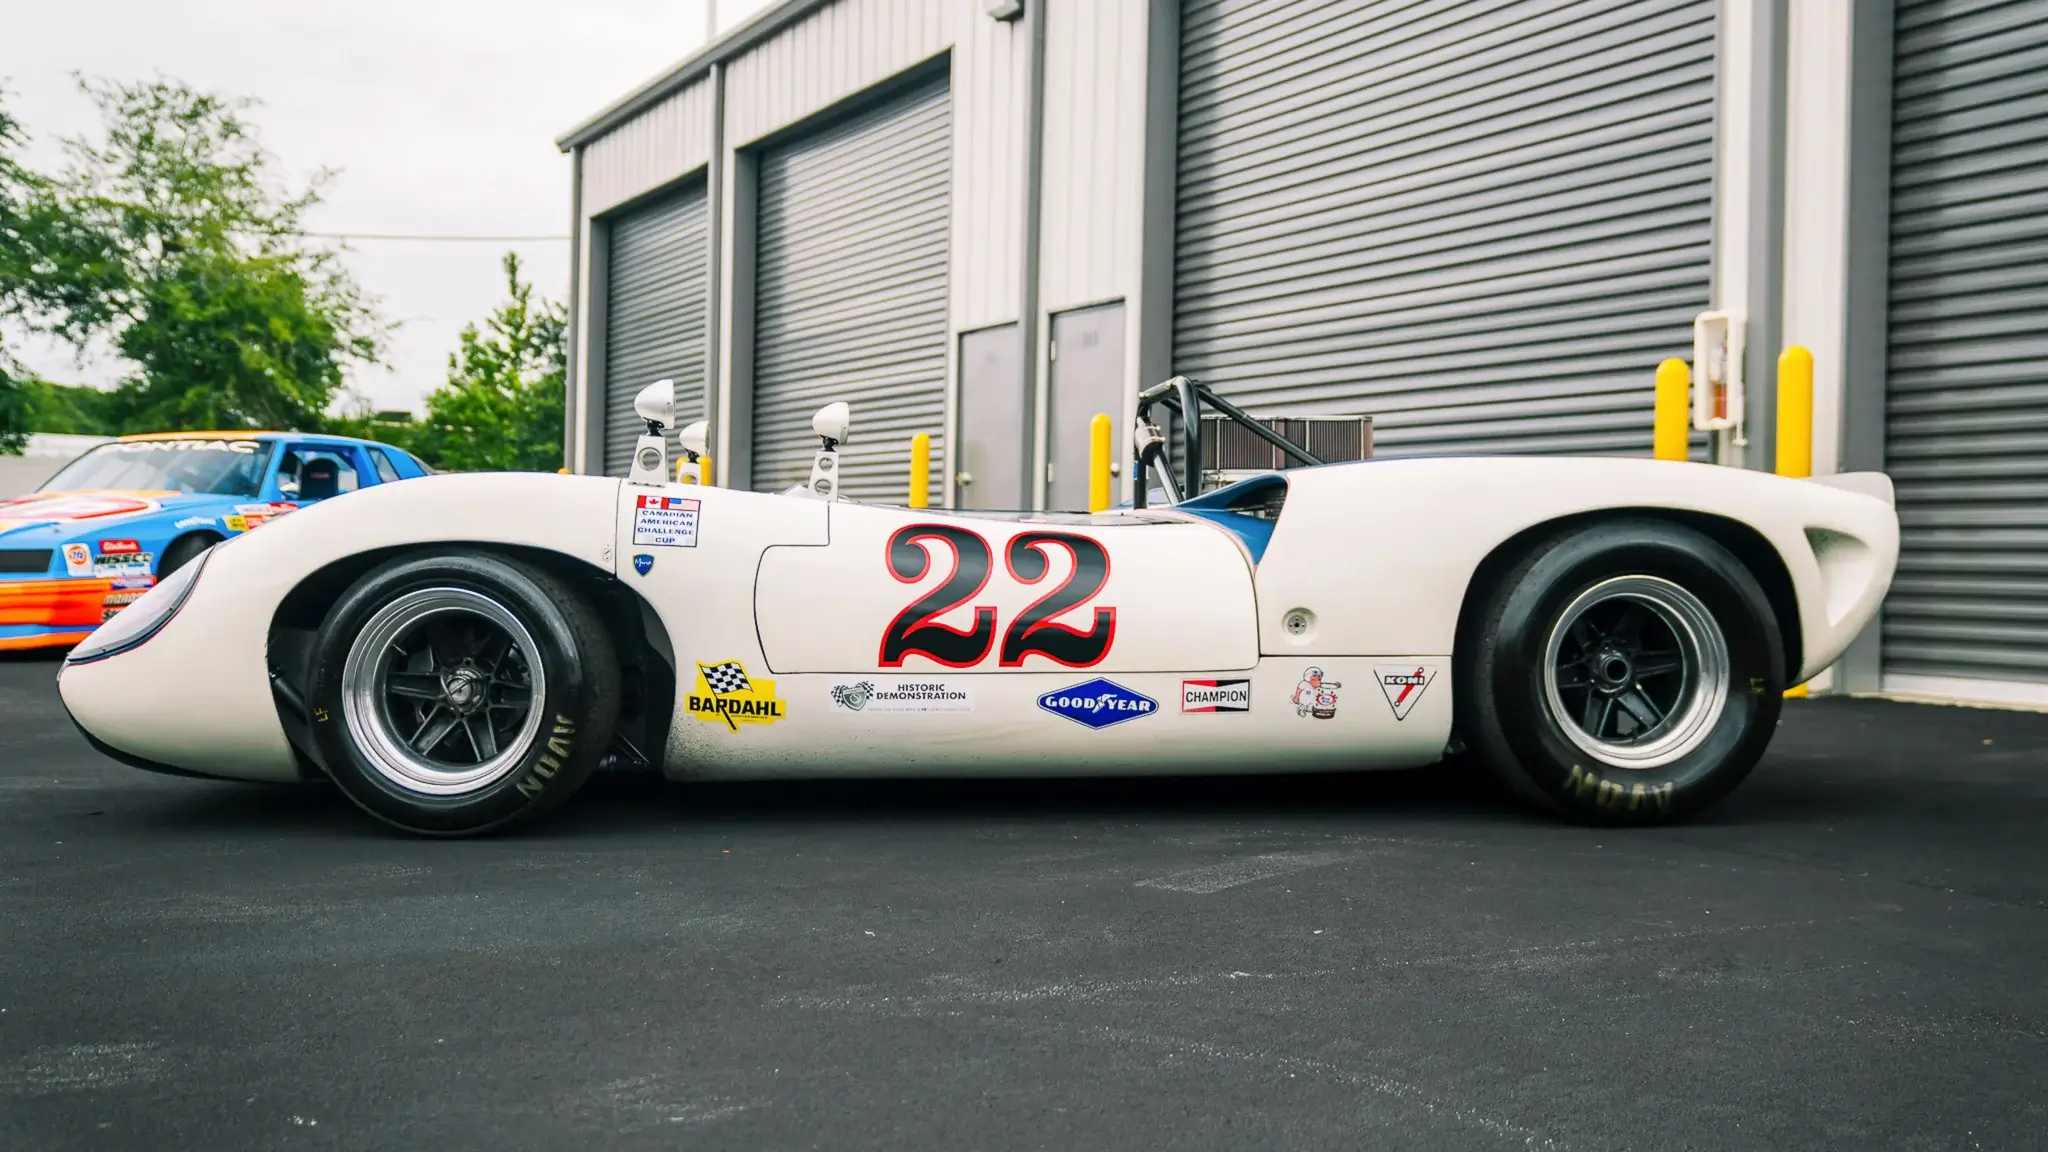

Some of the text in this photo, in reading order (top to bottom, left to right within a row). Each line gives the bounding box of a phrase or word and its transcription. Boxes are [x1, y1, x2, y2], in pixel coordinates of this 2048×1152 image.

[642, 510, 693, 518] CANADIAN
[637, 527, 694, 535] CHALLENGE
[878, 523, 1116, 668] 22
[1385, 676, 1424, 684] KONI
[897, 684, 945, 692] HISTORIC
[876, 692, 966, 700] DEMONSTRATION
[1186, 690, 1247, 703] CHAMPION
[689, 696, 781, 716] BARDAHL
[516, 713, 576, 798] AVON
